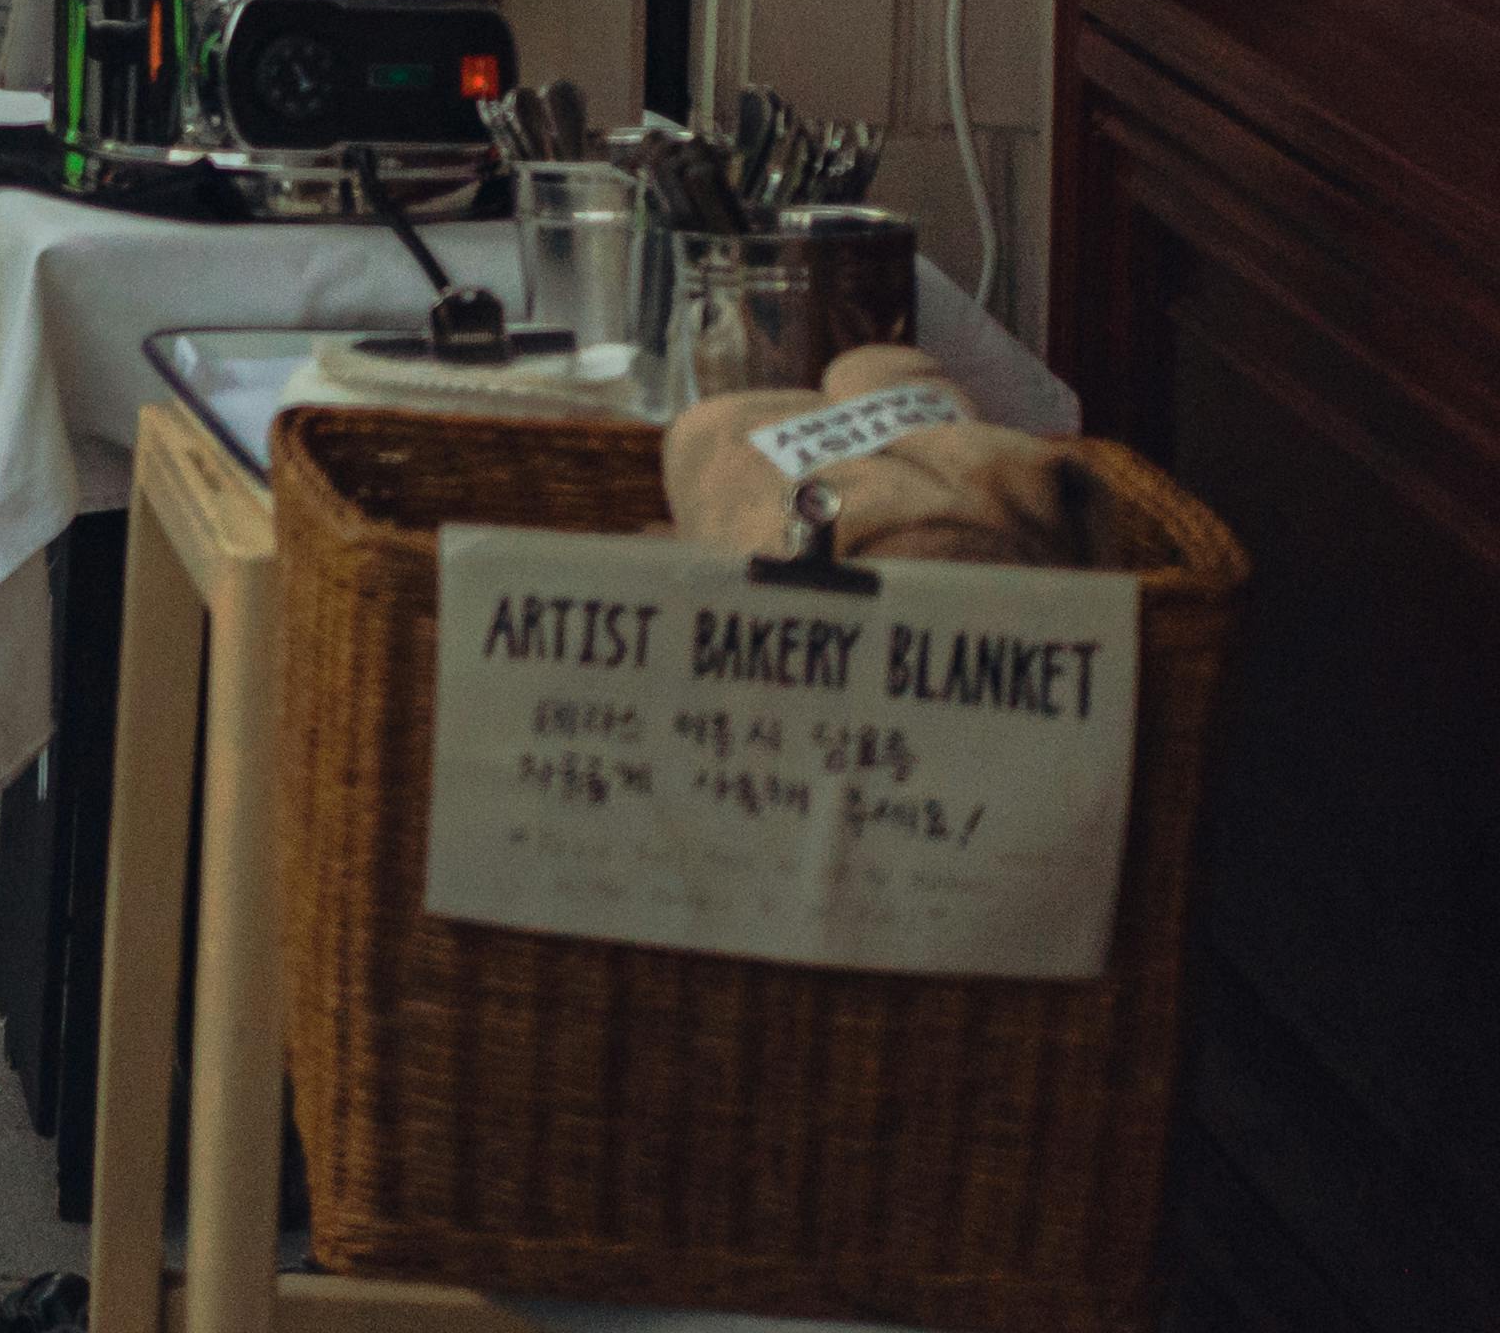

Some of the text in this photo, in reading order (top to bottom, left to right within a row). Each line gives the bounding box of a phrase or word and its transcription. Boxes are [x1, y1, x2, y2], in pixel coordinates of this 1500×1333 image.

[484, 594, 1102, 719] ARTIST BAKERY BLANKET
